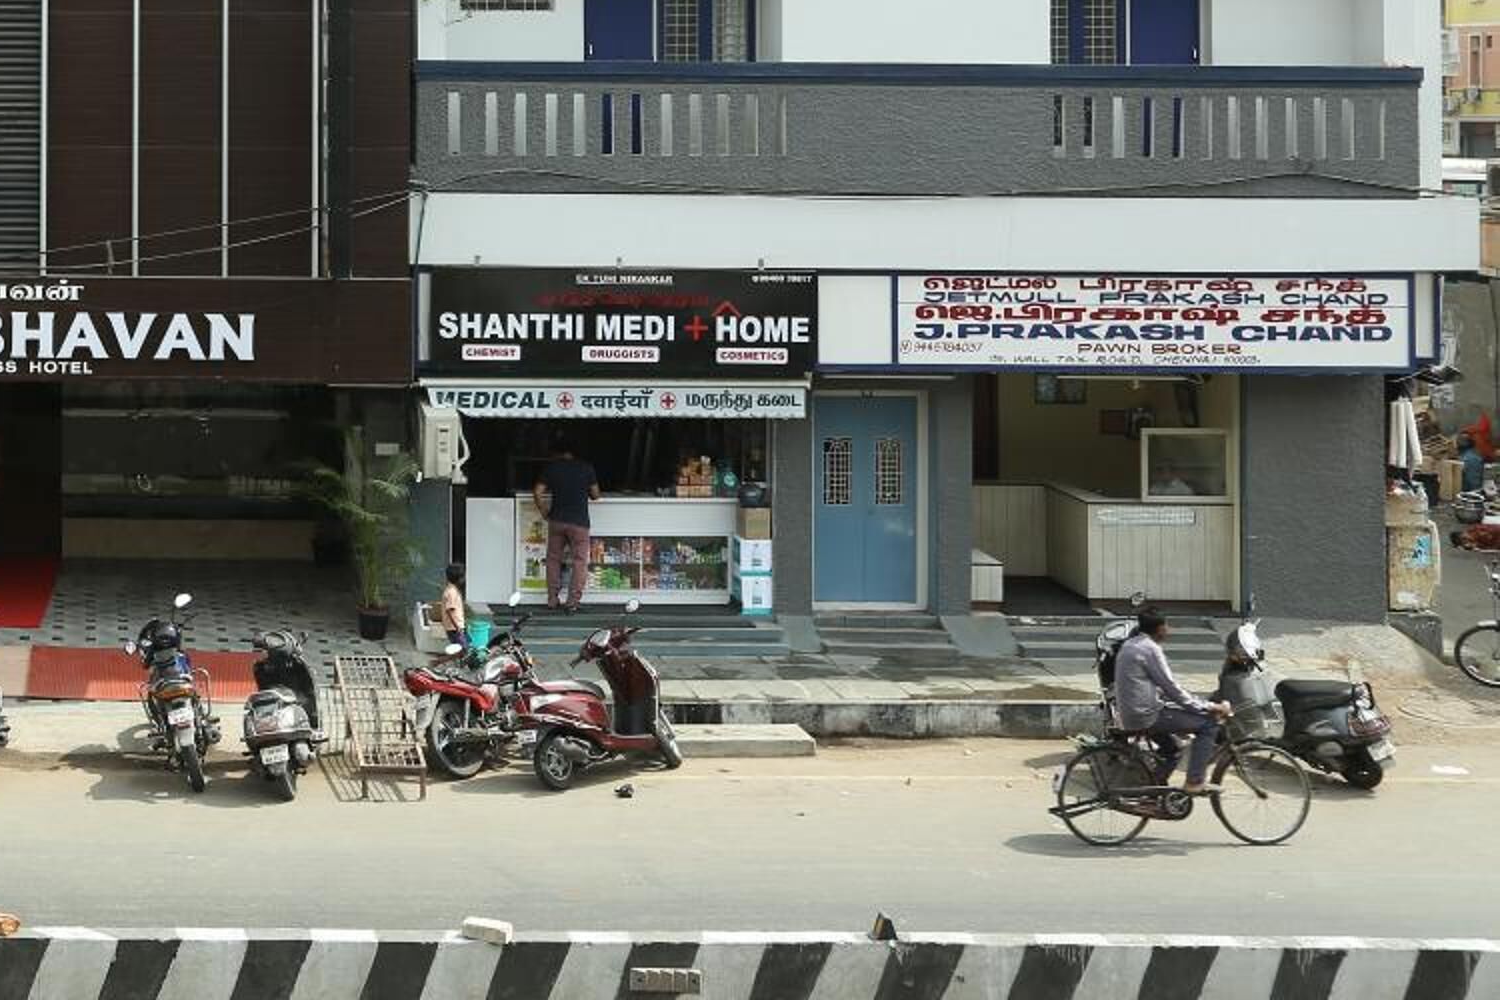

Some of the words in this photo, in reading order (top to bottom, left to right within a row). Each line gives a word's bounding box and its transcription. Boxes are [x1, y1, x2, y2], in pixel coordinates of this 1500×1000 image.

[924, 291, 1076, 303] JETMULL
[1099, 292, 1265, 305] PRAKASH
[1281, 293, 1388, 306] CHAND
[438, 312, 584, 341] SHANTHI
[595, 315, 675, 342] MEDI
[715, 316, 810, 343] HOME
[914, 323, 1205, 341] J.PRAKASH
[1231, 325, 1393, 342] CHAND
[466, 345, 516, 358] CHEMIST
[589, 347, 655, 360] DRUGGISTS
[719, 350, 785, 361] COSMETICS
[1077, 343, 1141, 354] PAWN
[1151, 343, 1241, 355] BROKER
[29, 360, 93, 375] HOTEL
[686, 389, 752, 412] மருந்து
[757, 393, 802, 407] கடை
